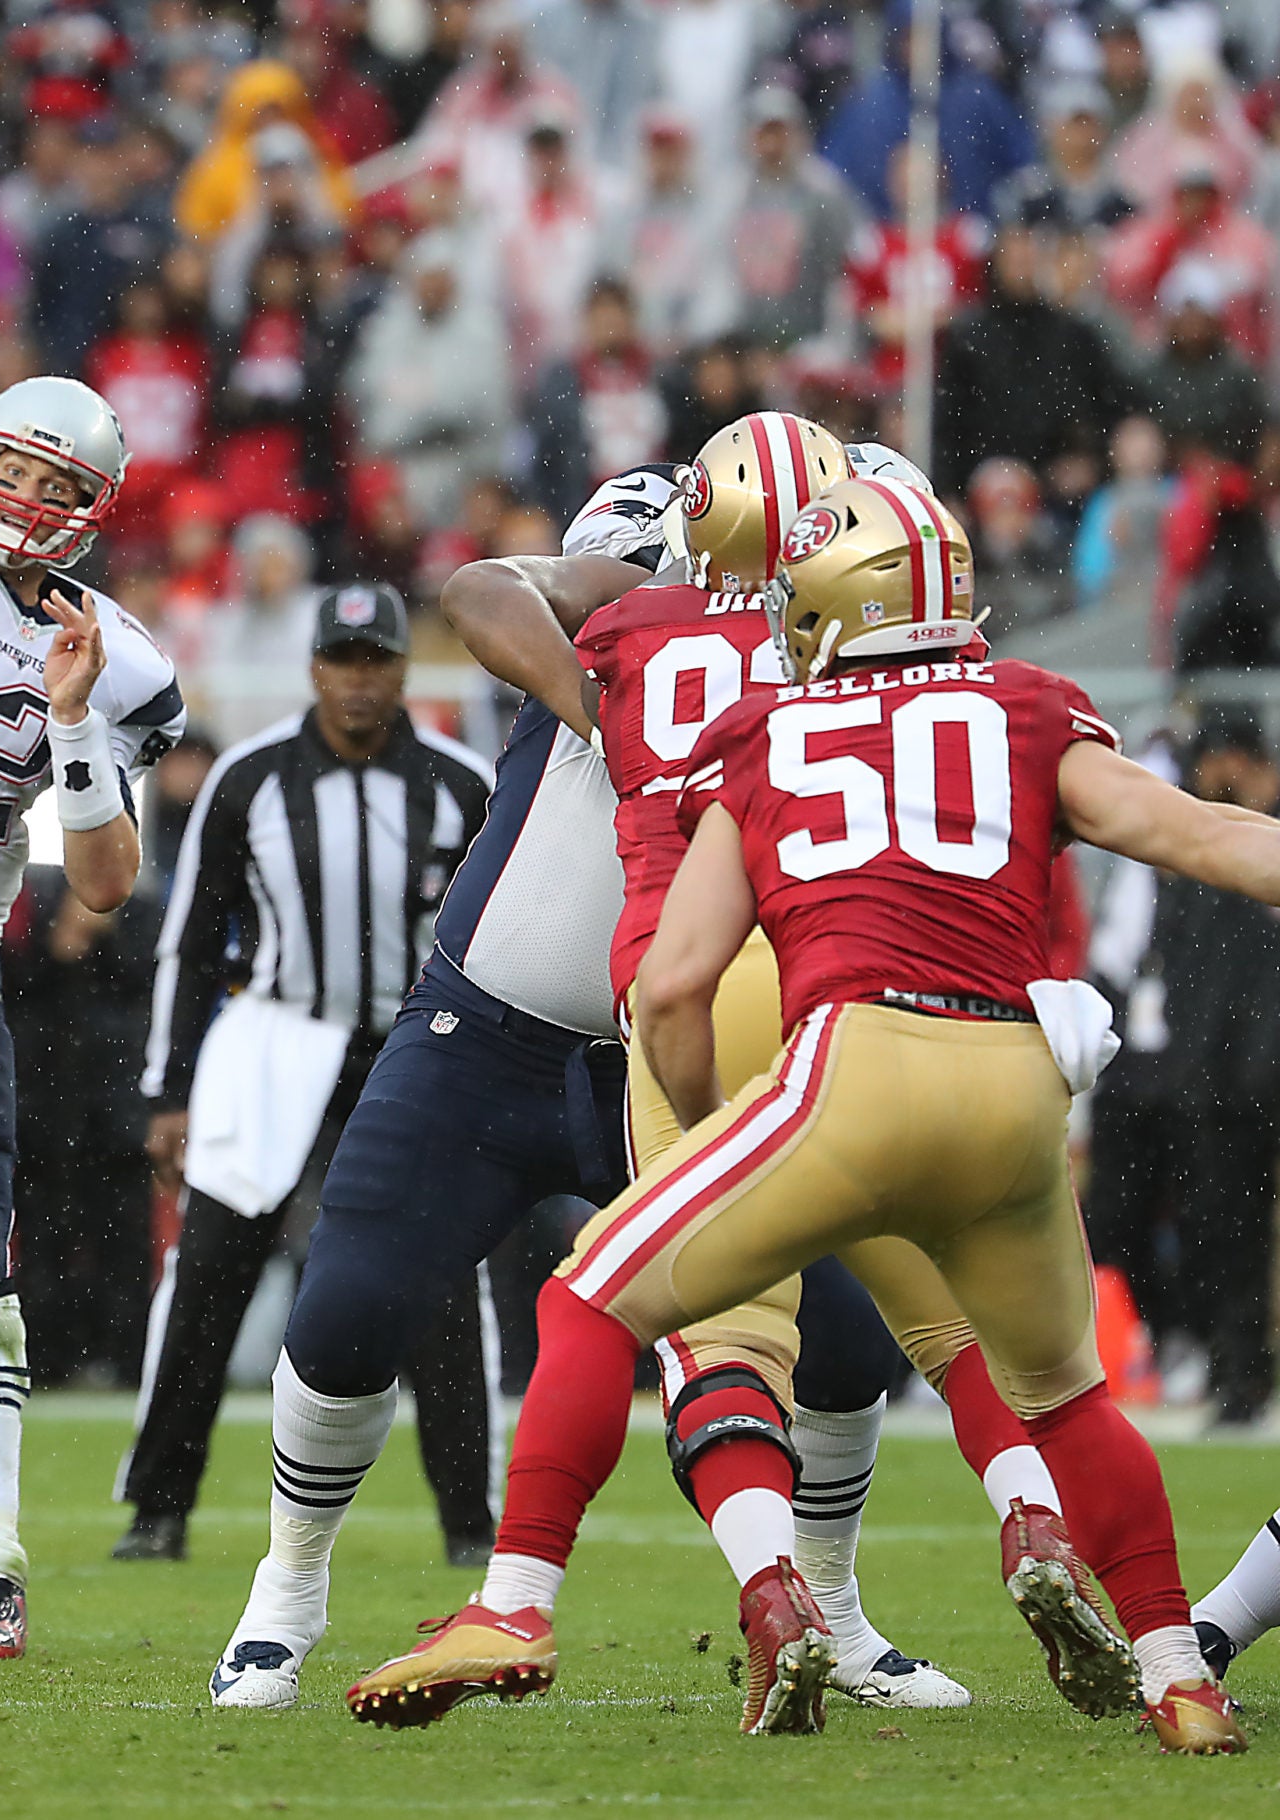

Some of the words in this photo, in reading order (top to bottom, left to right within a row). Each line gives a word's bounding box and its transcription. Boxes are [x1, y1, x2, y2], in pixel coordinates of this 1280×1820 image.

[907, 627, 957, 642] 49ERS
[776, 661, 995, 703] BELLORE
[767, 691, 1012, 882] 50
